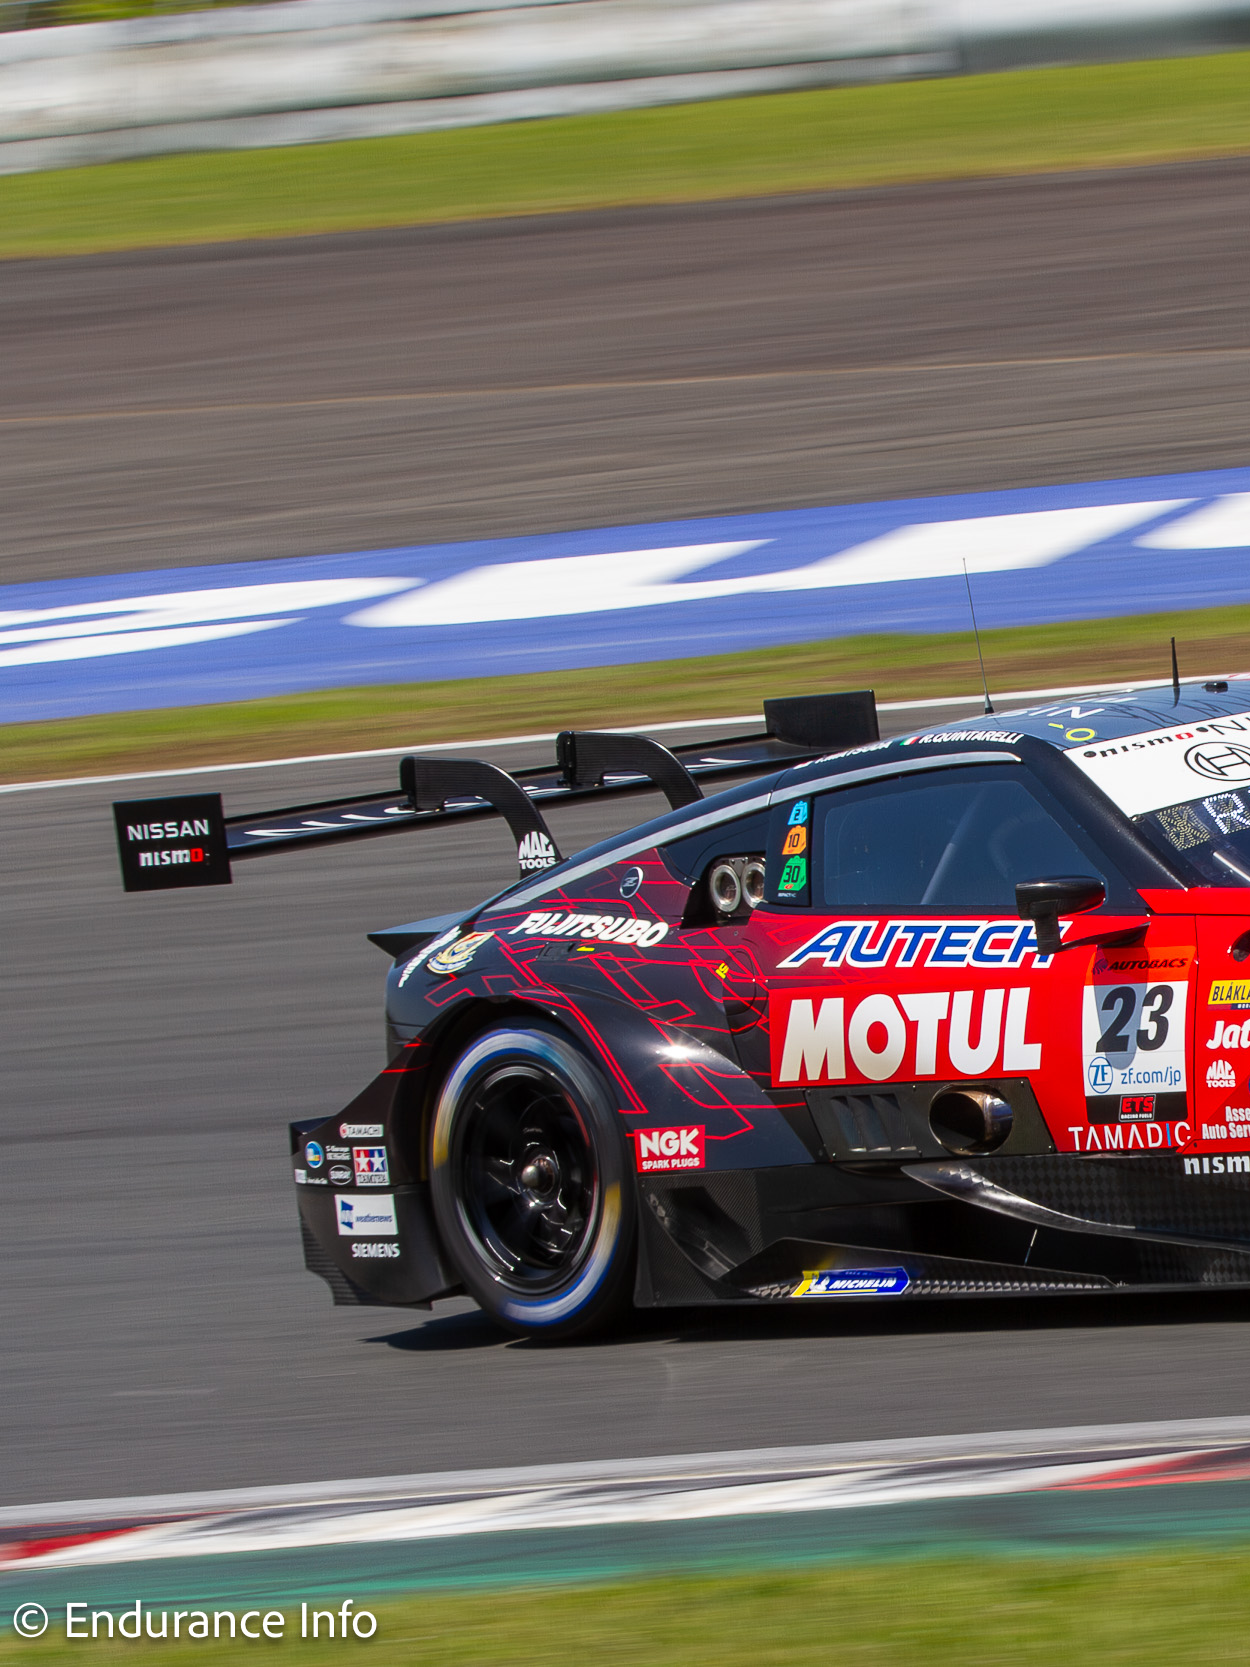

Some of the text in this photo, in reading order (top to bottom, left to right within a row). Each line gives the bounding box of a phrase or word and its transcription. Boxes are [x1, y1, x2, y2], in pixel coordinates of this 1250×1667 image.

[919, 730, 1025, 744] R.QUINTARELLI
[1100, 731, 1195, 758] nismo
[127, 818, 210, 841] NISSAN
[518, 831, 556, 860] MAC
[788, 833, 800, 848] 10
[139, 847, 204, 867] nismo
[518, 856, 557, 870] TOOLS
[783, 866, 801, 883] 30
[507, 912, 670, 948] FUJITSUBO
[776, 920, 1074, 969] AUTECH
[1109, 958, 1189, 971] AUTOBACS
[1095, 984, 1174, 1054] 23
[778, 986, 1043, 1083] MOTUL
[1120, 1066, 1182, 1086] zf.com/jp
[1206, 1059, 1237, 1080] MAC
[1206, 1080, 1237, 1088] TOOLS
[1121, 1096, 1154, 1113] ETS
[1068, 1121, 1192, 1152] TAMADIC
[1201, 1122, 1228, 1140] Auto
[640, 1127, 700, 1158] NGK
[642, 1157, 700, 1170] SPARK PLUGS
[351, 1242, 401, 1258] SIEMENS
[828, 1277, 898, 1290] MICHELIN
